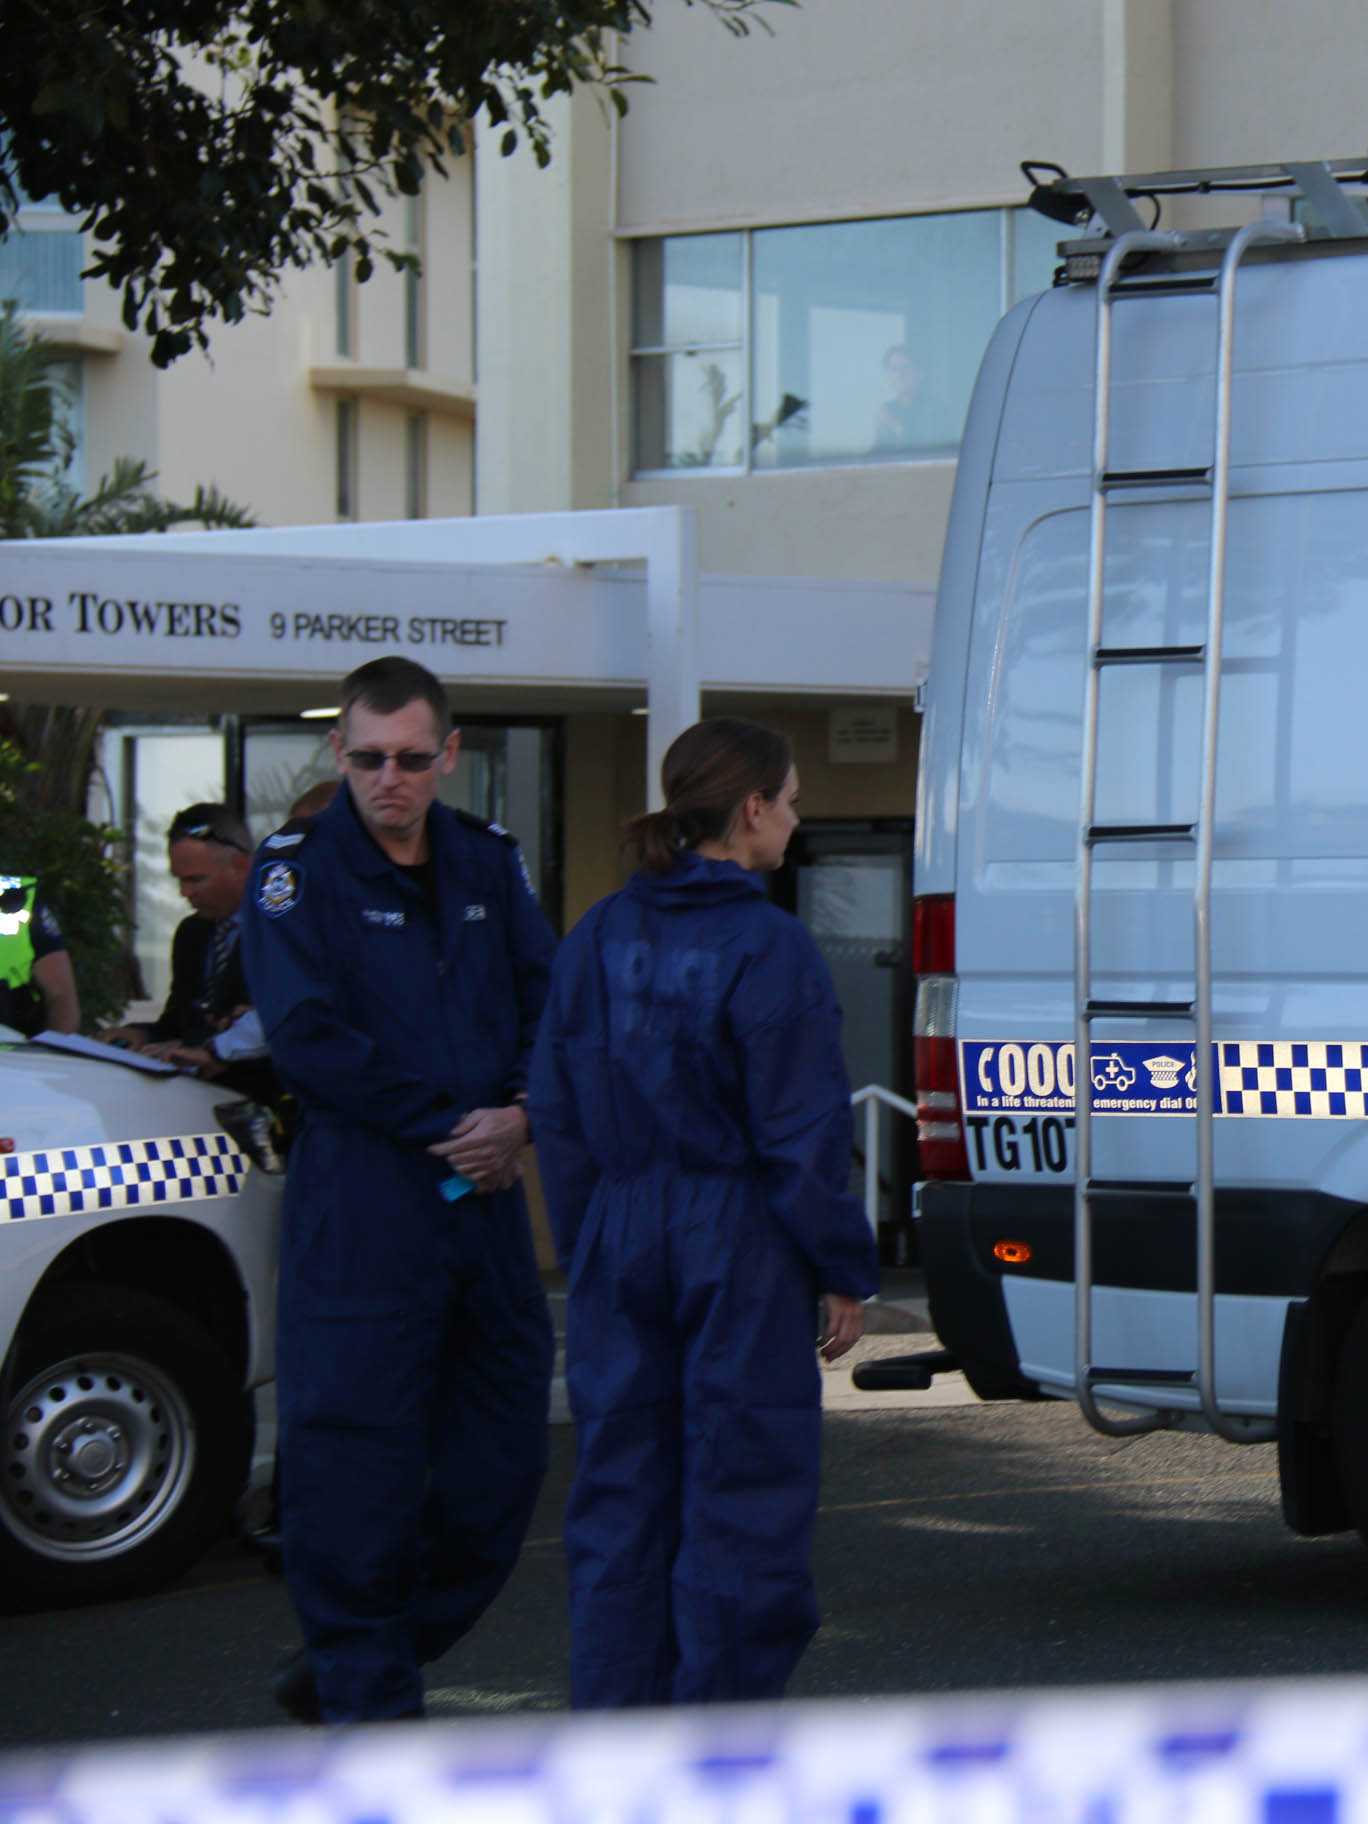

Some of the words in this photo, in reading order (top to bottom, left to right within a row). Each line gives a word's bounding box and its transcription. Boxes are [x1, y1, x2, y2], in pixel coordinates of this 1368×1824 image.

[269, 611, 287, 640] 9
[293, 612, 401, 643] PARKER
[408, 617, 507, 647] STREET
[977, 1095, 989, 1107] In
[991, 1099, 999, 1107] a
[1002, 1095, 1021, 1108] life
[1024, 1096, 1075, 1108] threateni
[1093, 1098, 1157, 1111] emergency
[1160, 1097, 1182, 1109] dial
